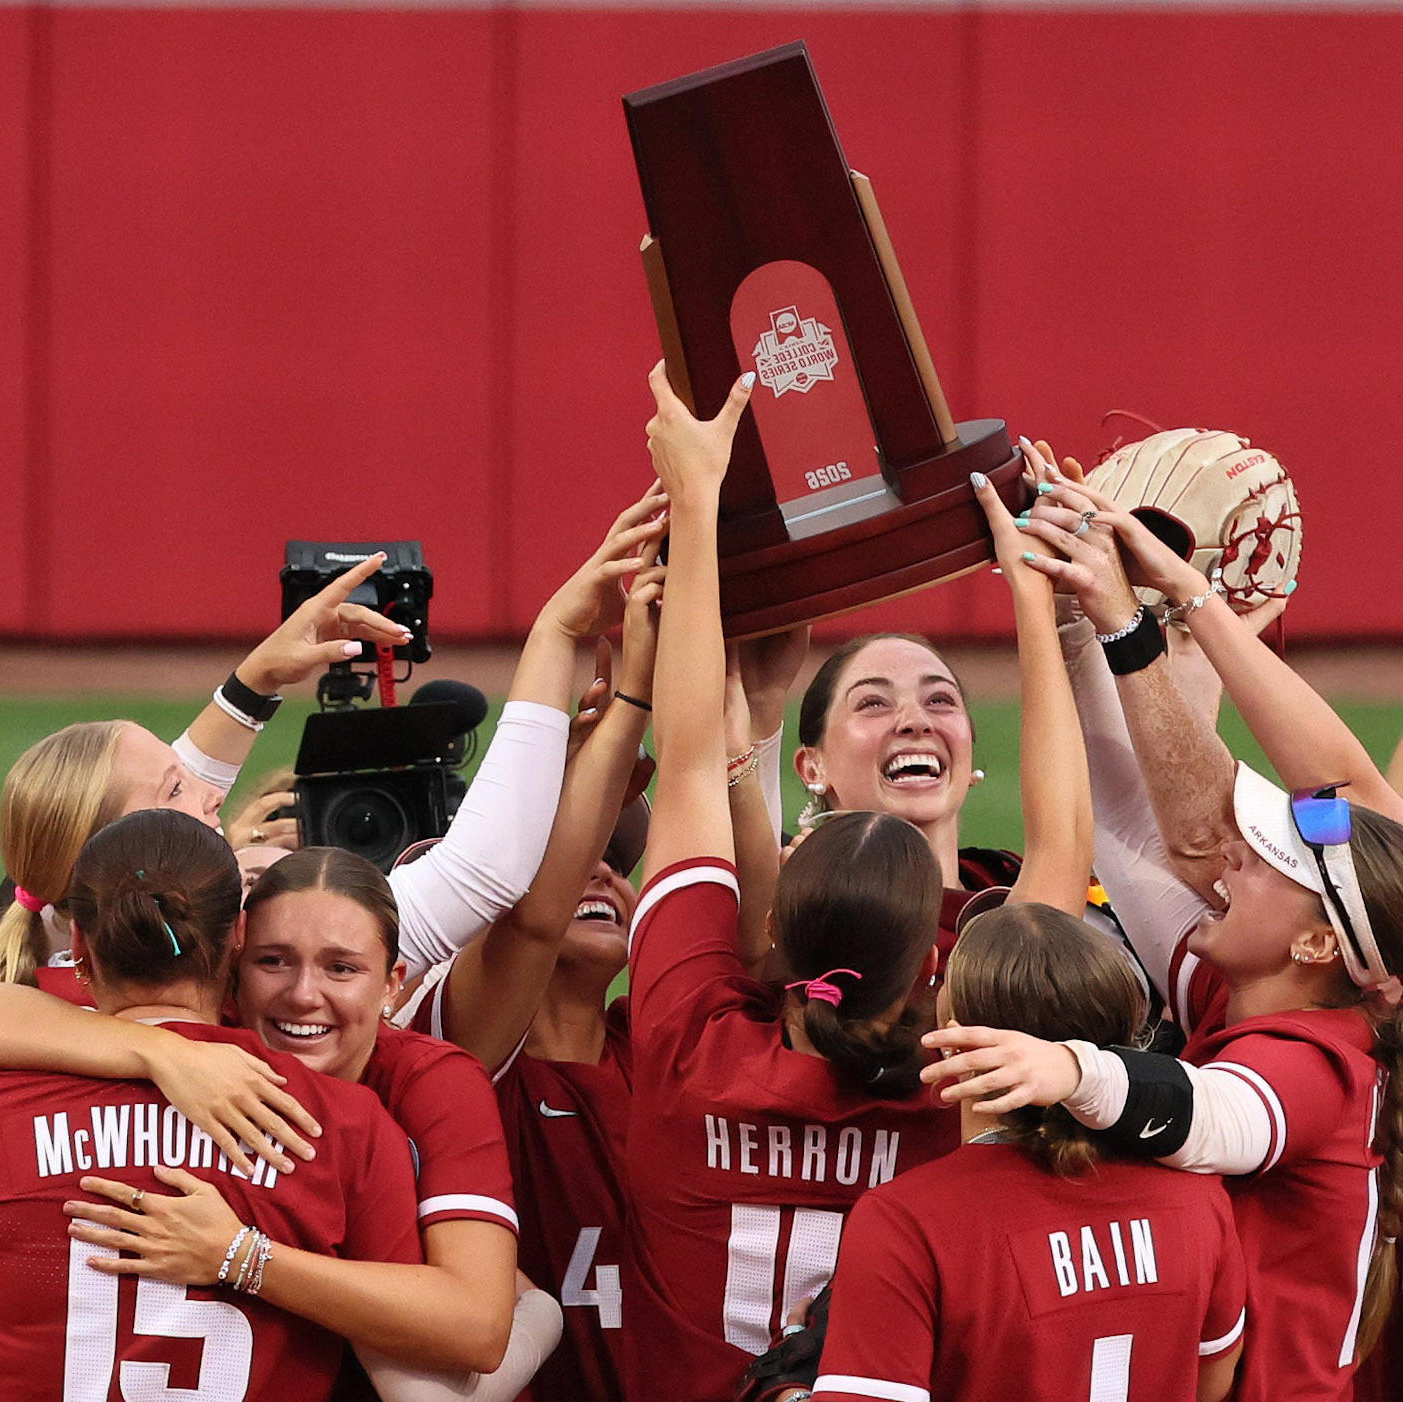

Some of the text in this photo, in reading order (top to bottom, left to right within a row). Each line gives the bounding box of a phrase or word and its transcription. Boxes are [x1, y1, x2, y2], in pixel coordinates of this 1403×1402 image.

[1226, 454, 1266, 480] EASTON
[1248, 825, 1299, 869] ARKANSAS
[705, 1114, 899, 1189] HERRON
[1048, 1219, 1158, 1297] BAIN
